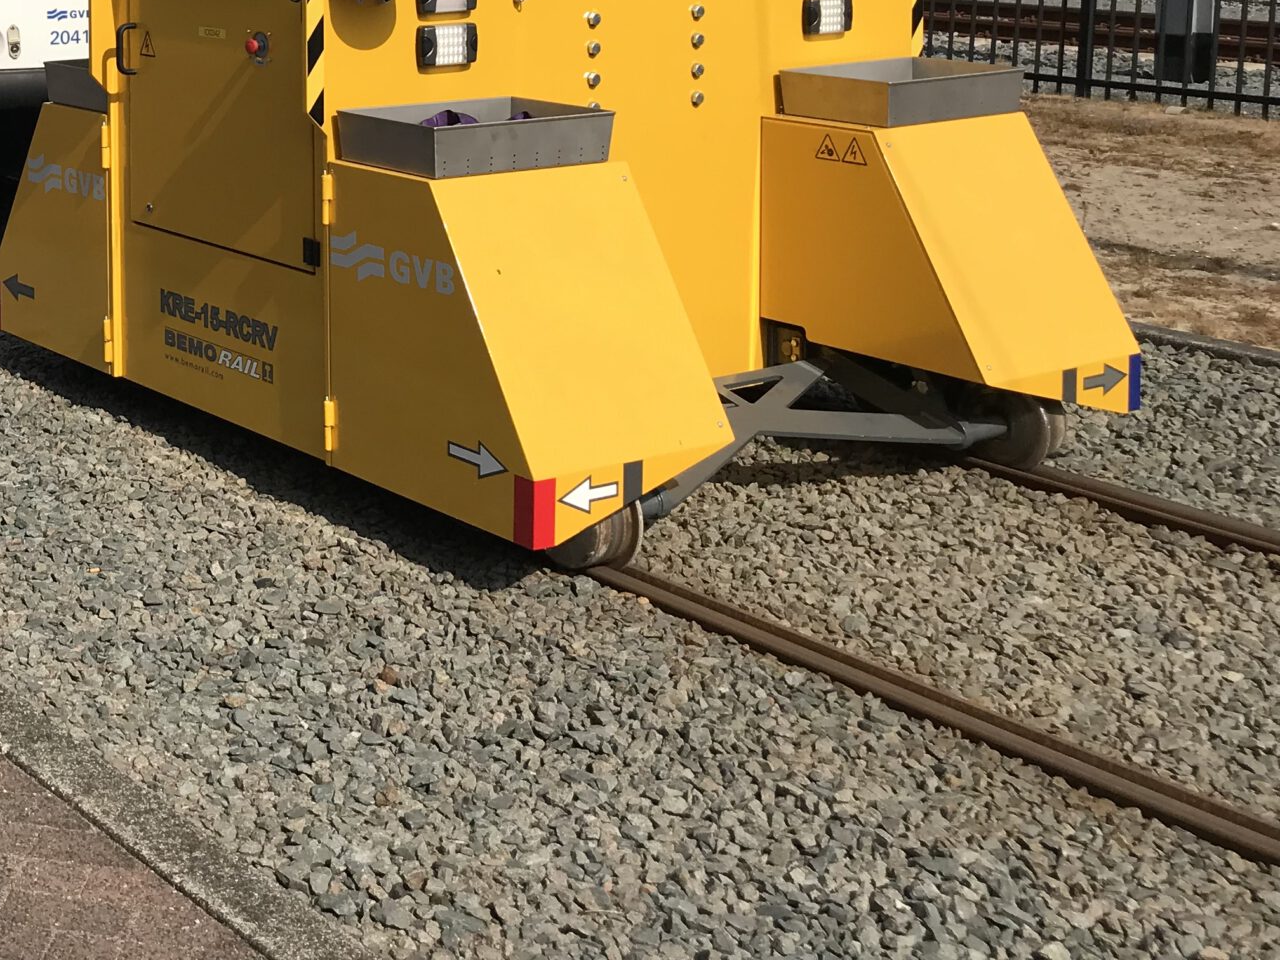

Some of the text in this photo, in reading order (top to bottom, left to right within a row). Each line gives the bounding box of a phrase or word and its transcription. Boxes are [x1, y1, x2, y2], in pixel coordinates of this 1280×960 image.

[50, 29, 89, 45] 2041
[64, 167, 106, 201] GVB
[389, 250, 455, 295] GVB
[160, 287, 279, 352] KRE-15-RCRV
